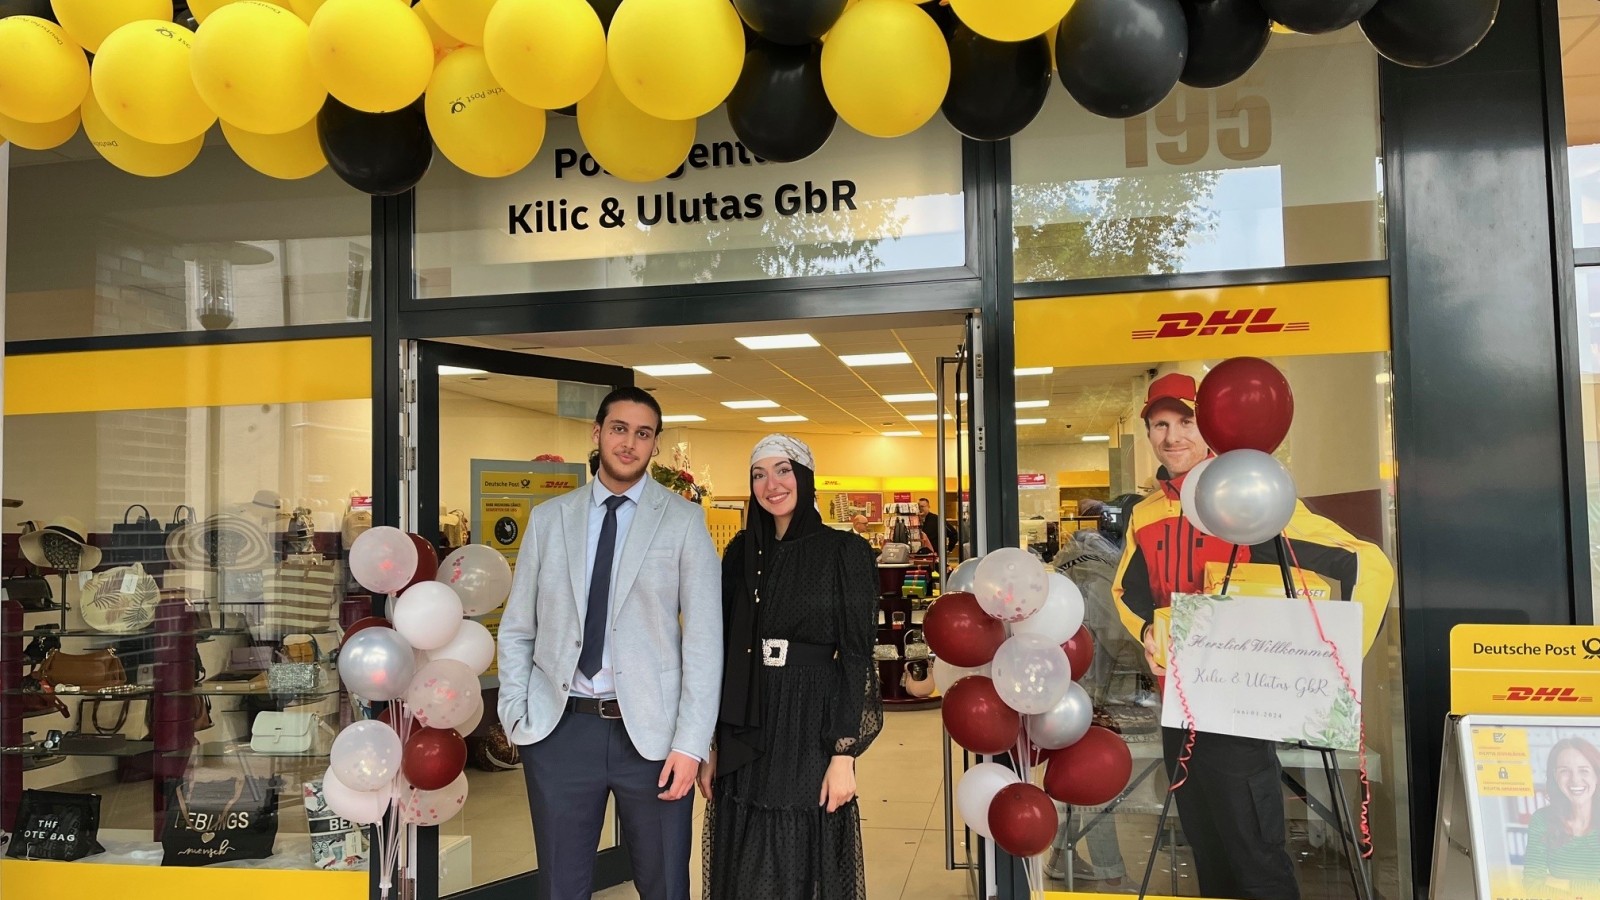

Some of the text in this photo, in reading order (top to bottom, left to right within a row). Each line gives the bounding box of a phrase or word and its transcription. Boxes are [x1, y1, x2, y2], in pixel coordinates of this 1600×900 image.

[466, 91, 486, 103] Post
[1125, 82, 1272, 169] 195
[508, 180, 857, 234] Kilic & Ulutas GbR
[1155, 308, 1285, 338] DHL
[544, 481, 571, 489] DHL
[1188, 634, 1250, 652] Herzlich
[1473, 642, 1576, 656] Deutsche Post
[1192, 667, 1330, 698] Kilic & Ulutas GbR
[1506, 686, 1580, 702] DHL
[24, 830, 76, 842] OTE BAG
